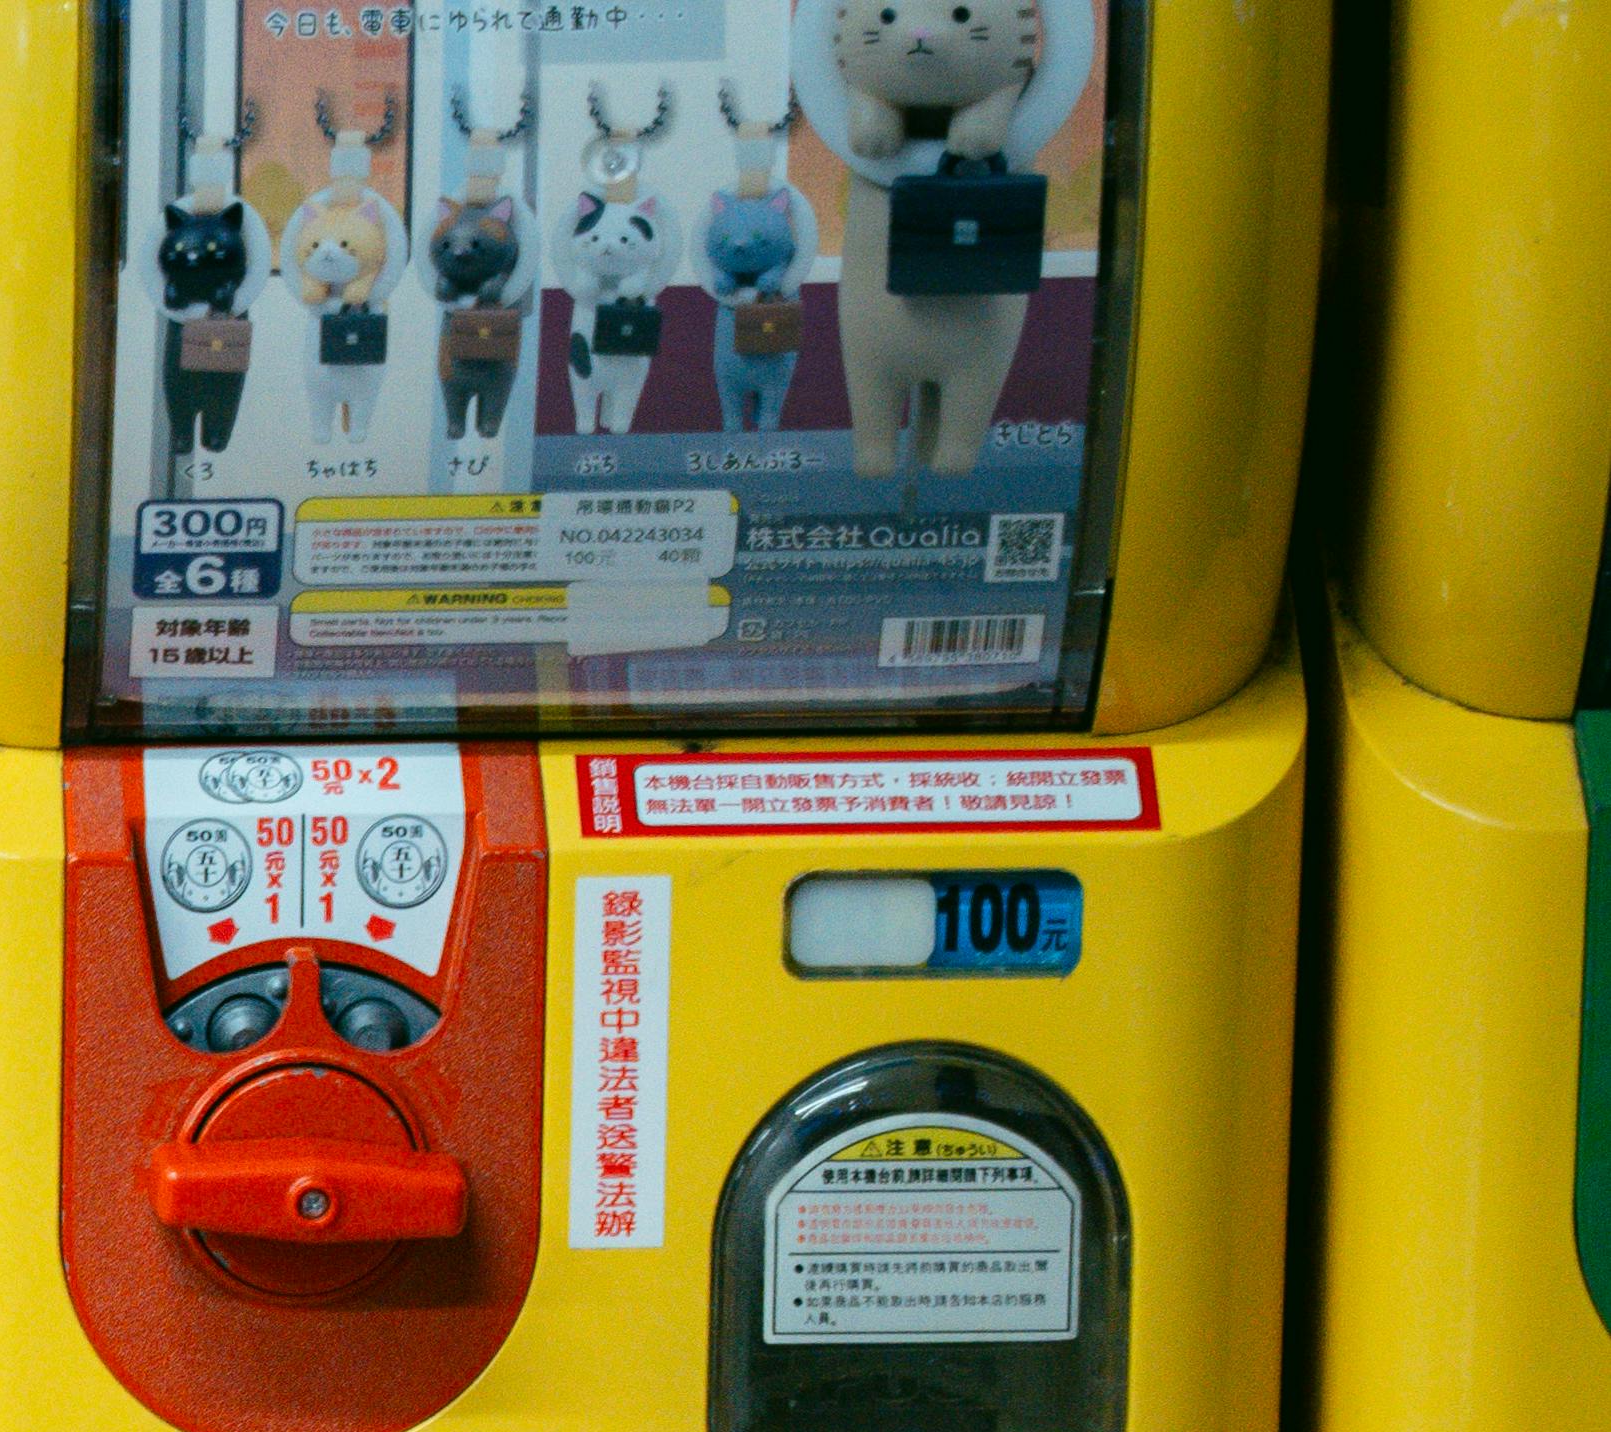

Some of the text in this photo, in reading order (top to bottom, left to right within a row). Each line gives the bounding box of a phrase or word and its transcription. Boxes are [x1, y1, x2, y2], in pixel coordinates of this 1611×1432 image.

[151, 508, 268, 538] 300円
[558, 526, 704, 544] NO.042243034
[153, 556, 261, 595] 全6種
[421, 592, 508, 606] WARNING
